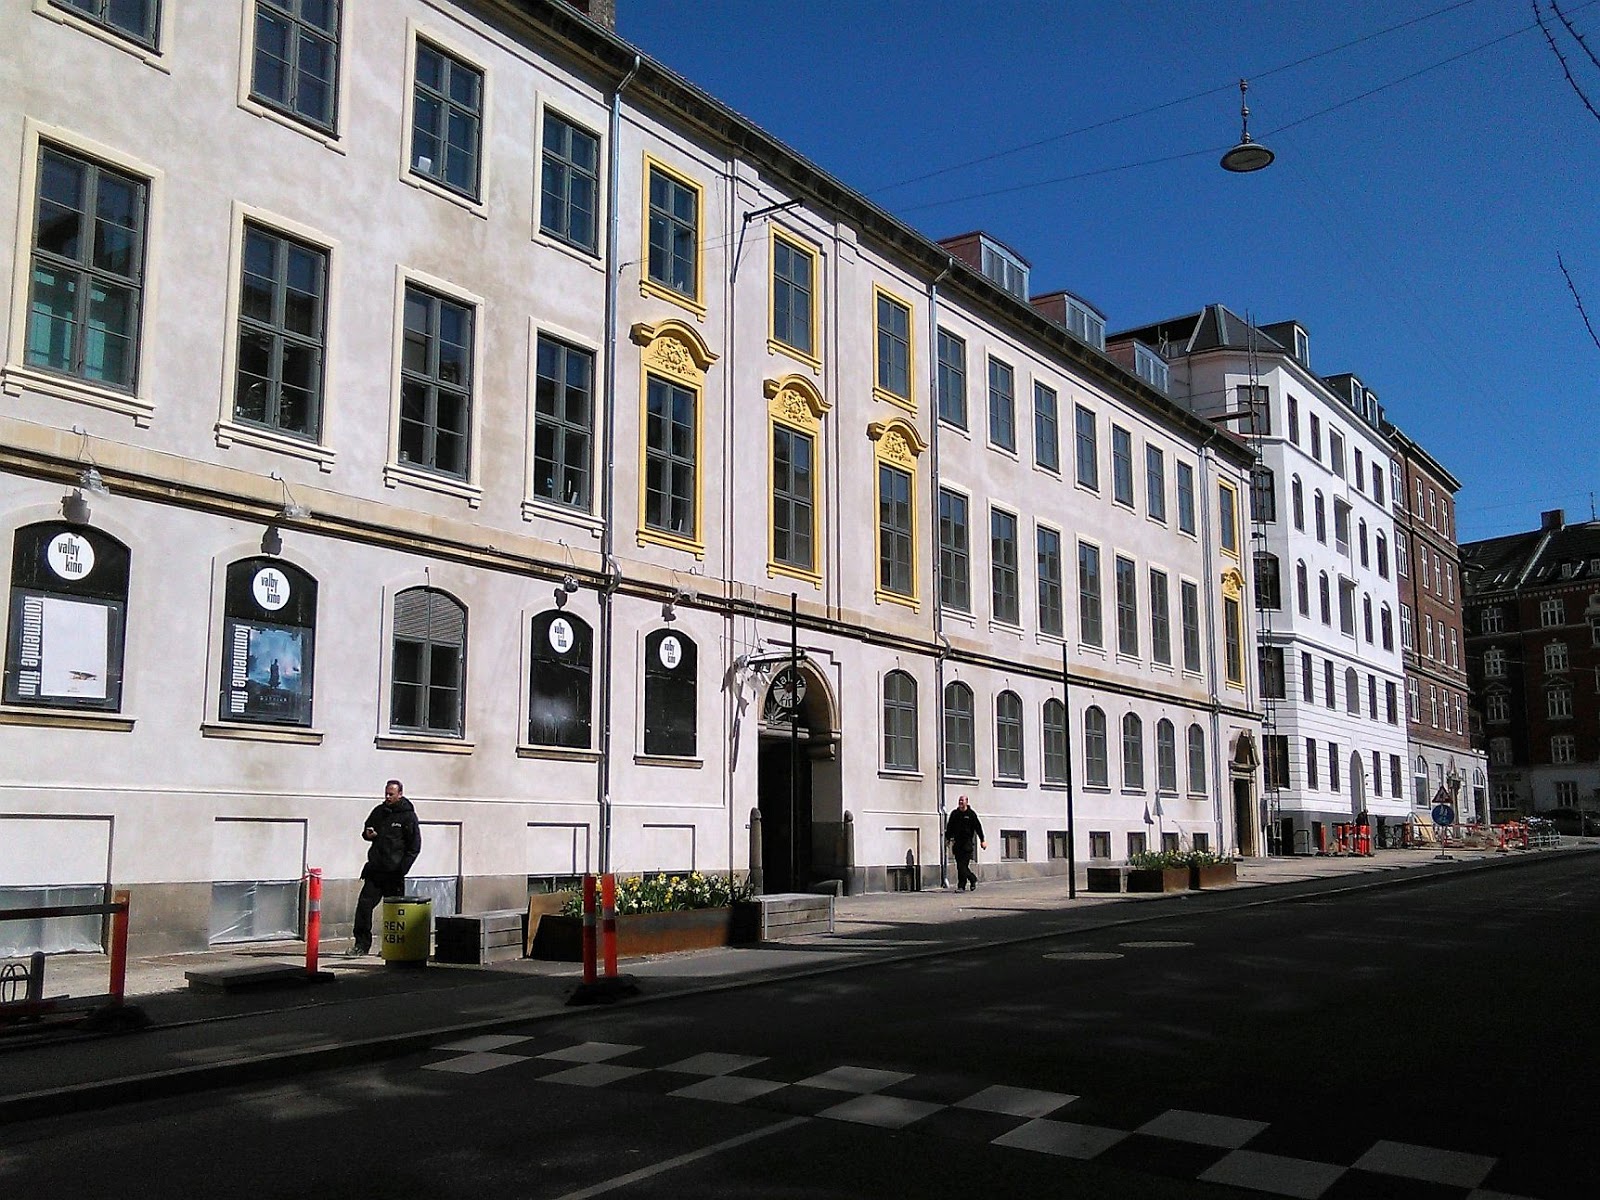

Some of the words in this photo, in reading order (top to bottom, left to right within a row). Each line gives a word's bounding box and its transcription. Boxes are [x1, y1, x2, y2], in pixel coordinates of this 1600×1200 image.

[58, 538, 80, 561] valby
[65, 555, 83, 573] kino
[261, 573, 279, 593] valby
[267, 587, 280, 604] kino
[20, 595, 43, 667] kommende
[232, 624, 252, 687] kommende
[18, 670, 41, 696] film
[231, 690, 249, 713] film
